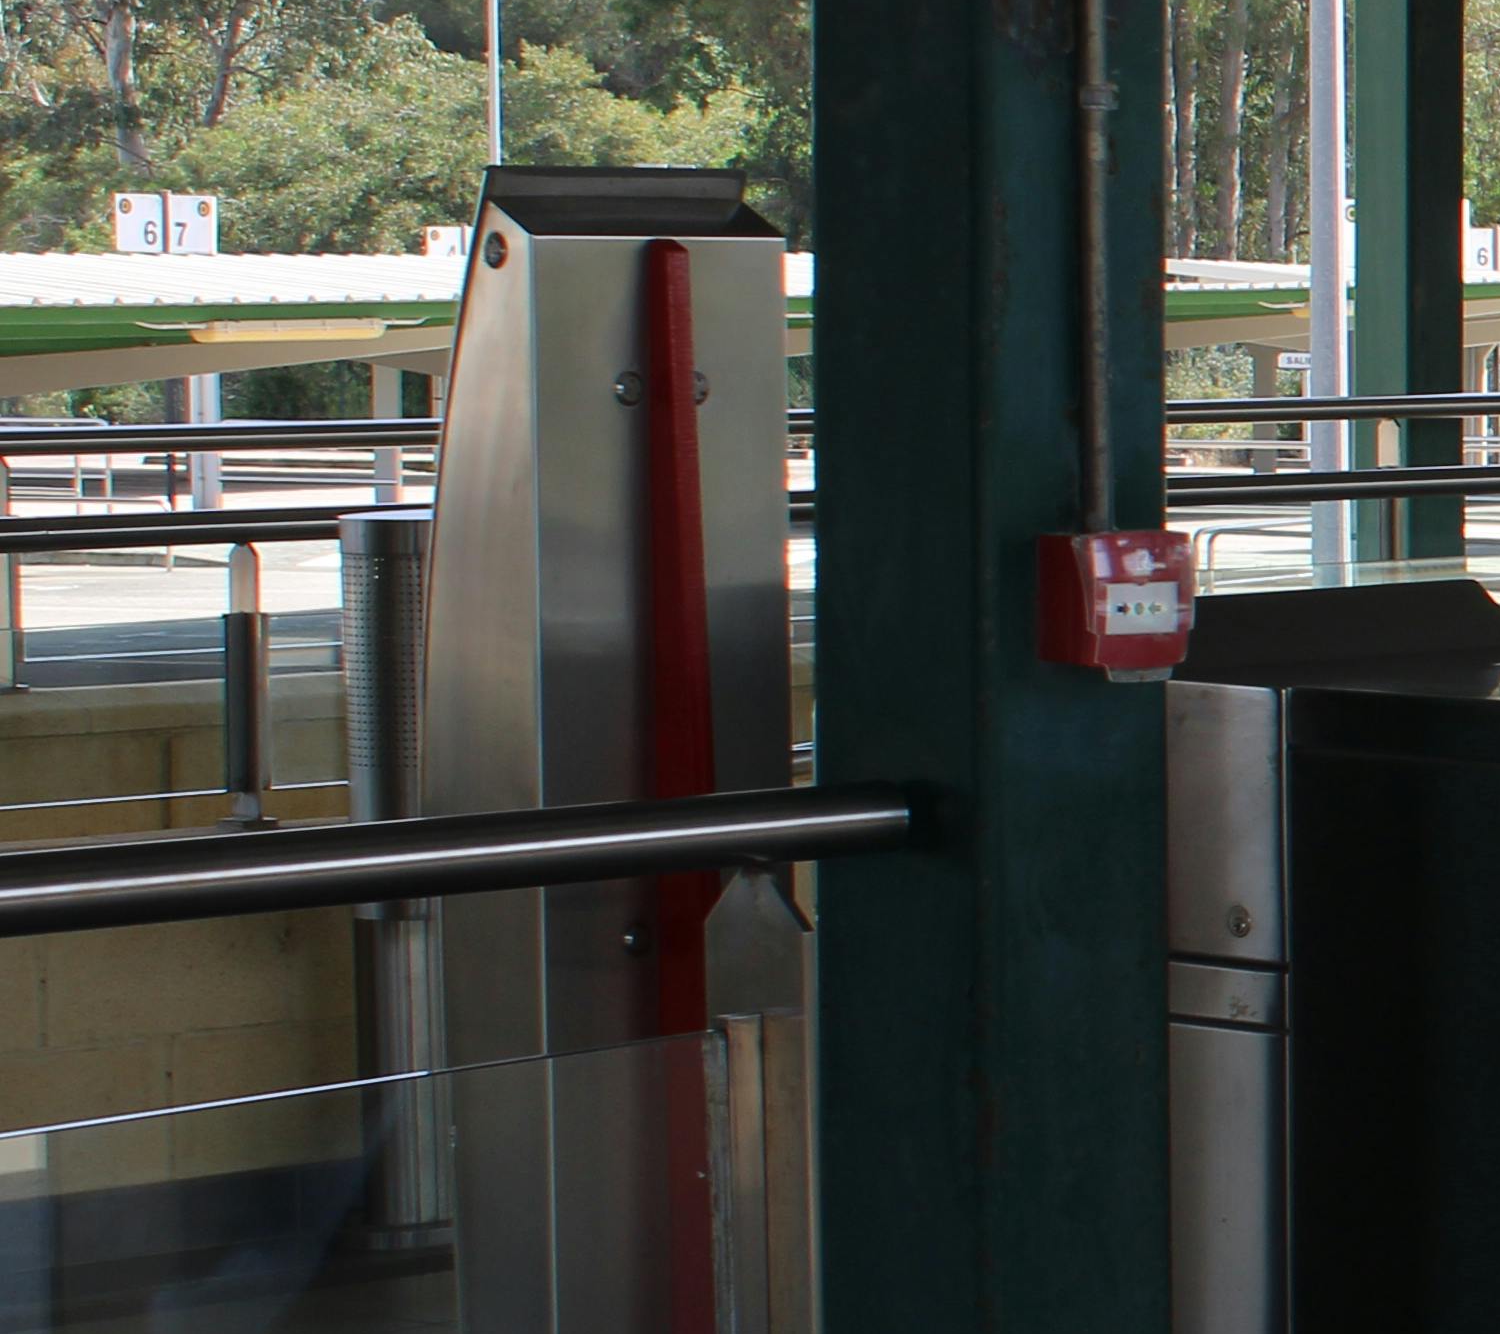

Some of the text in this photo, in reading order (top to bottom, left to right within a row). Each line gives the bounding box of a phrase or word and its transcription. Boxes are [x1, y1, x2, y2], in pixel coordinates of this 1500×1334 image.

[144, 220, 157, 245] 6
[174, 222, 187, 246] 7
[1476, 247, 1488, 266] 6
